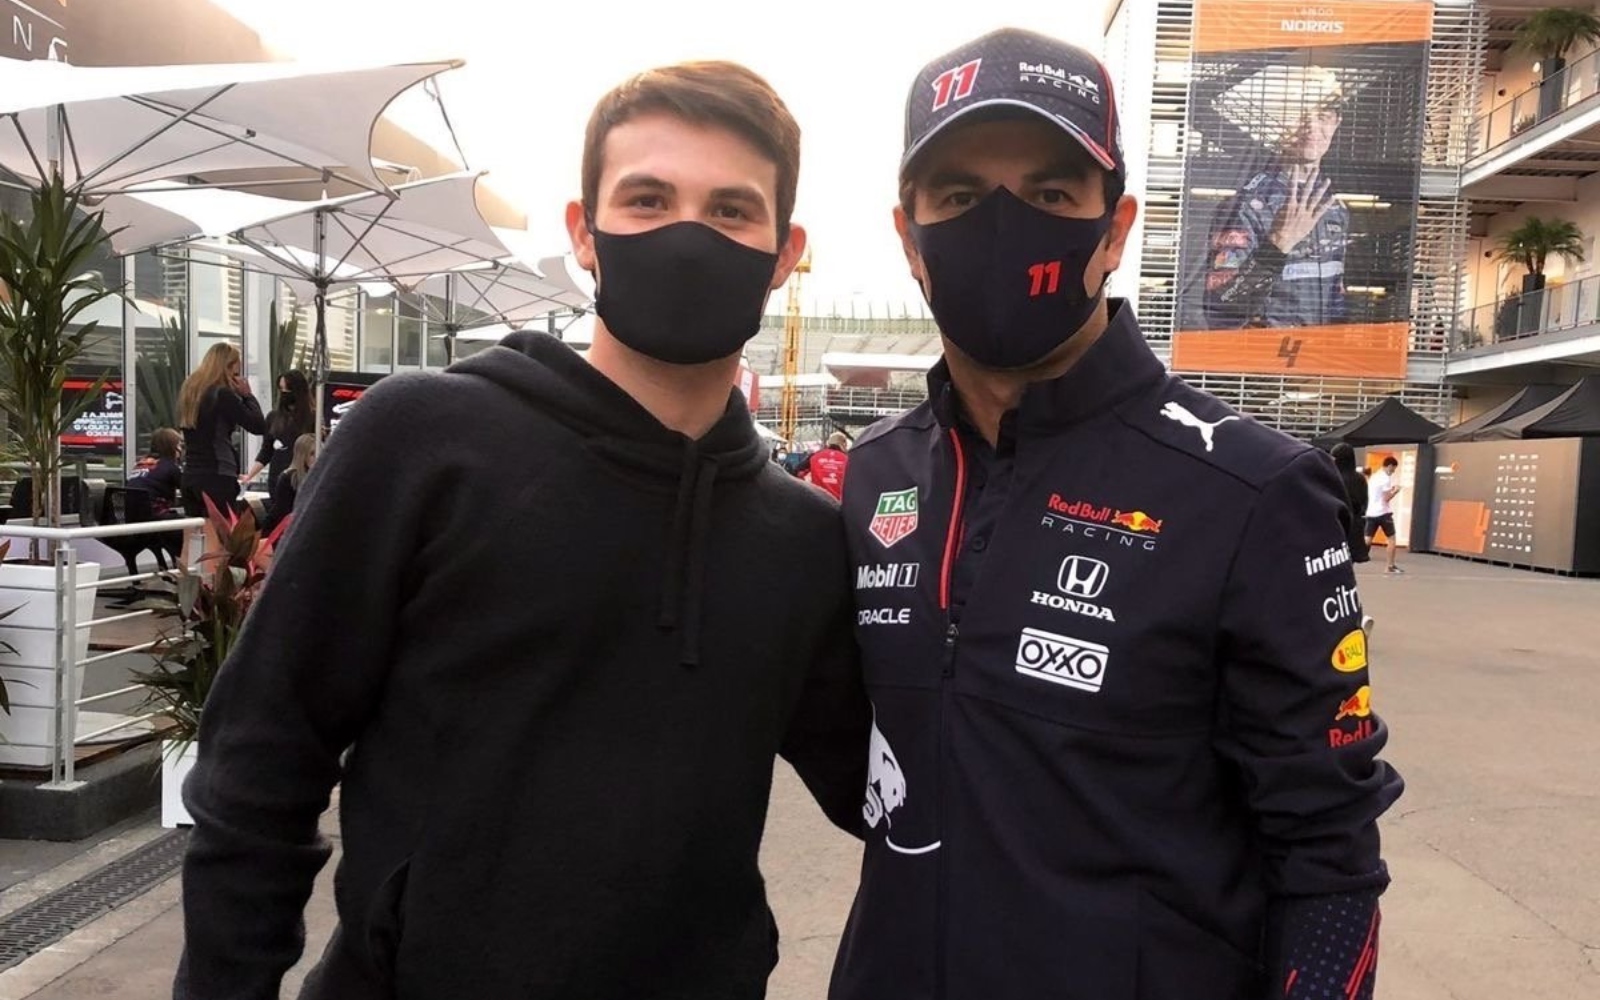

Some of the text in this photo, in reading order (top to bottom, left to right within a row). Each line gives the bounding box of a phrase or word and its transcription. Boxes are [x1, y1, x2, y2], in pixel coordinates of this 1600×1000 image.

[1281, 19, 1345, 33] NORRIS
[932, 58, 982, 112] 11
[1019, 75, 1099, 105] RACING
[1028, 260, 1061, 297] 11
[1278, 335, 1302, 368] 4
[883, 493, 916, 513] TAG
[872, 515, 916, 542] HEUER
[1041, 516, 1156, 551] RACING
[1305, 542, 1351, 576] infini
[857, 563, 898, 589] Mobil
[858, 608, 911, 625] ORACLE
[1030, 590, 1116, 622] HONDA
[1021, 639, 1102, 680] OXXO
